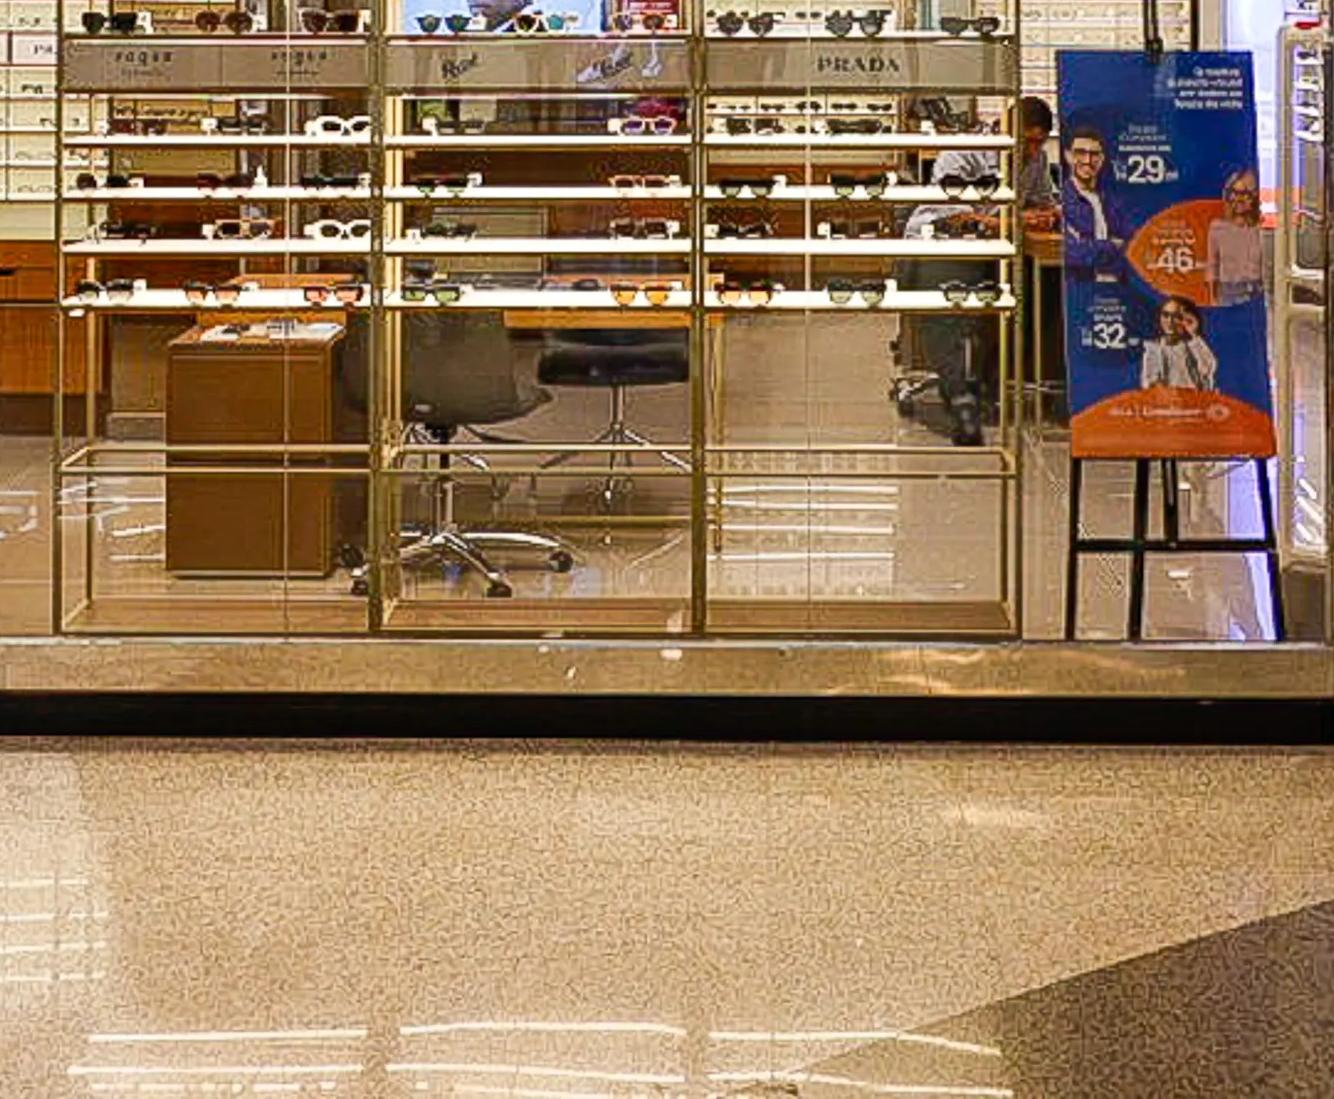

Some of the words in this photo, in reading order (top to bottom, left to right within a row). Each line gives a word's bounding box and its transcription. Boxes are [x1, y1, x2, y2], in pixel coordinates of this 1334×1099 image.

[815, 56, 901, 74] PRADA
[1127, 154, 1166, 185] 29
[1156, 245, 1195, 275] 46
